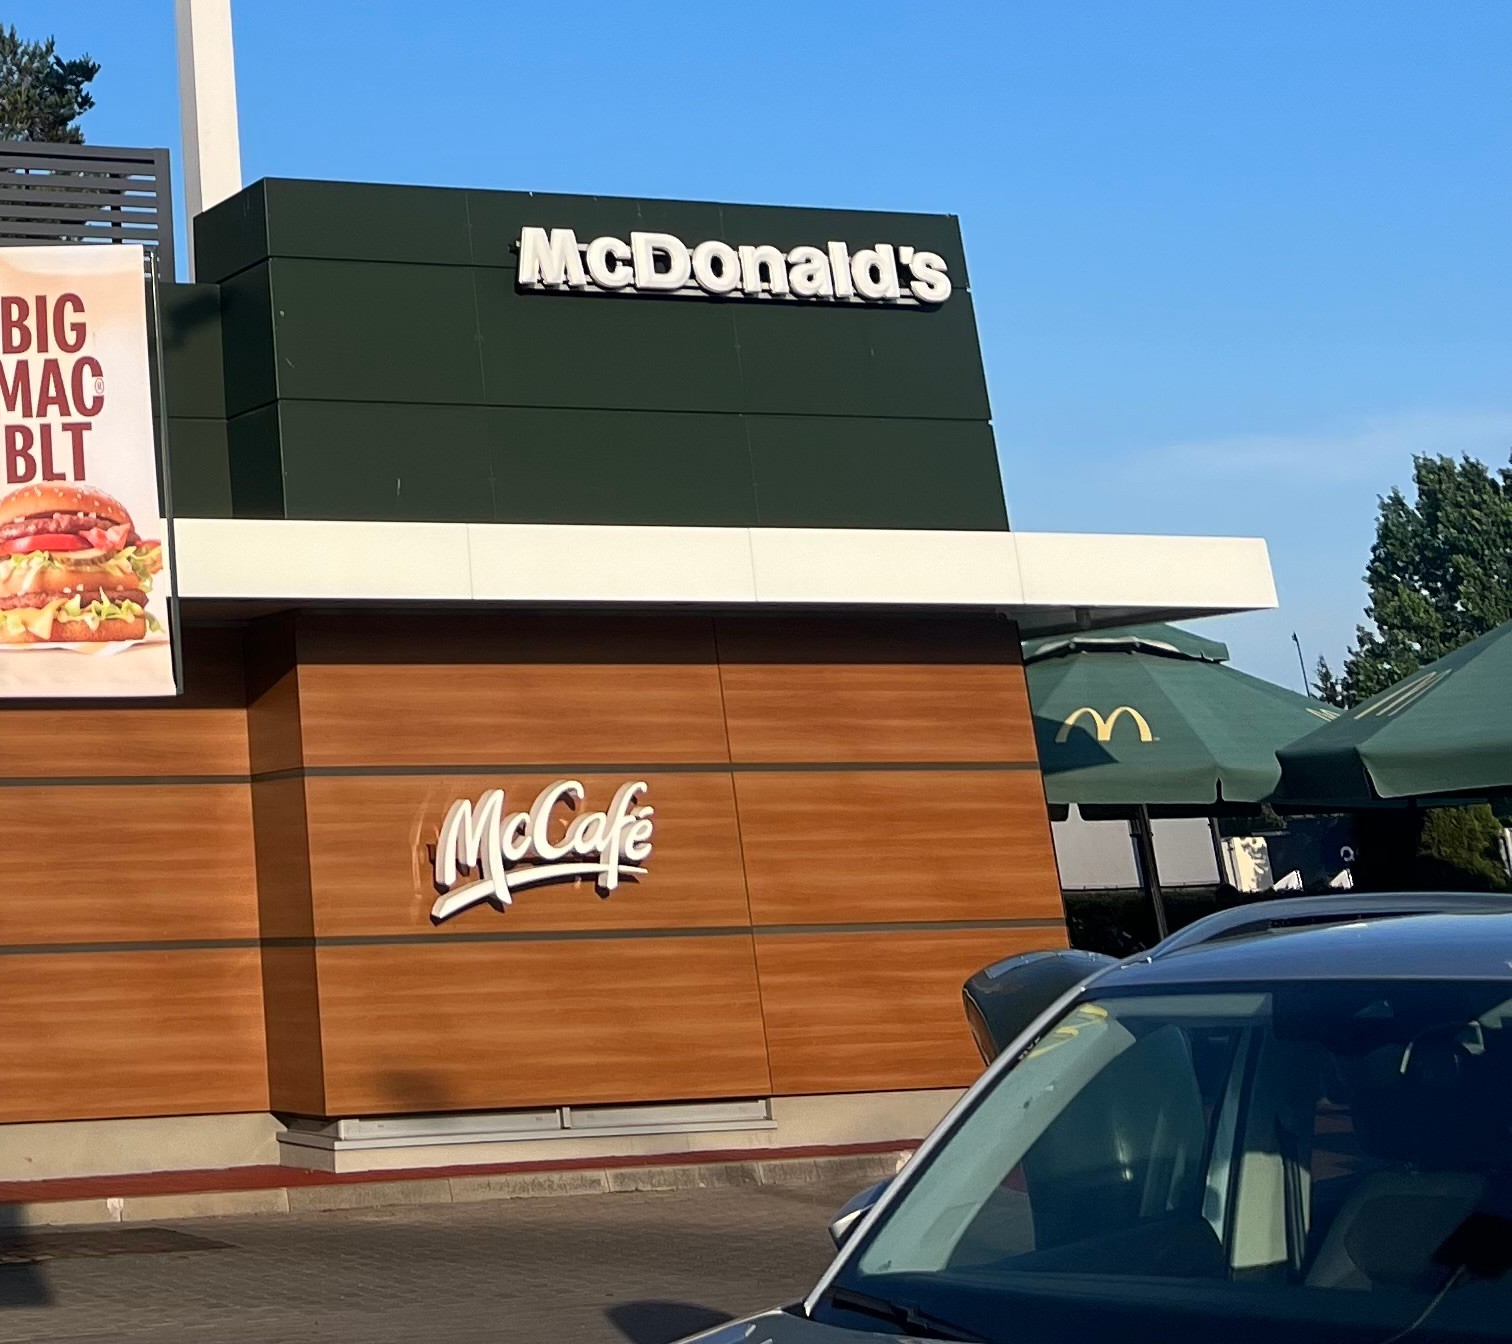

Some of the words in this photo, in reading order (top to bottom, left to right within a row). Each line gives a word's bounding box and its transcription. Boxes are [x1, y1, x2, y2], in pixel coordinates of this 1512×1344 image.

[517, 225, 953, 304] McDonald's
[0, 291, 87, 355] BIG
[4, 421, 93, 485] BLT
[431, 779, 655, 920] McCafé
